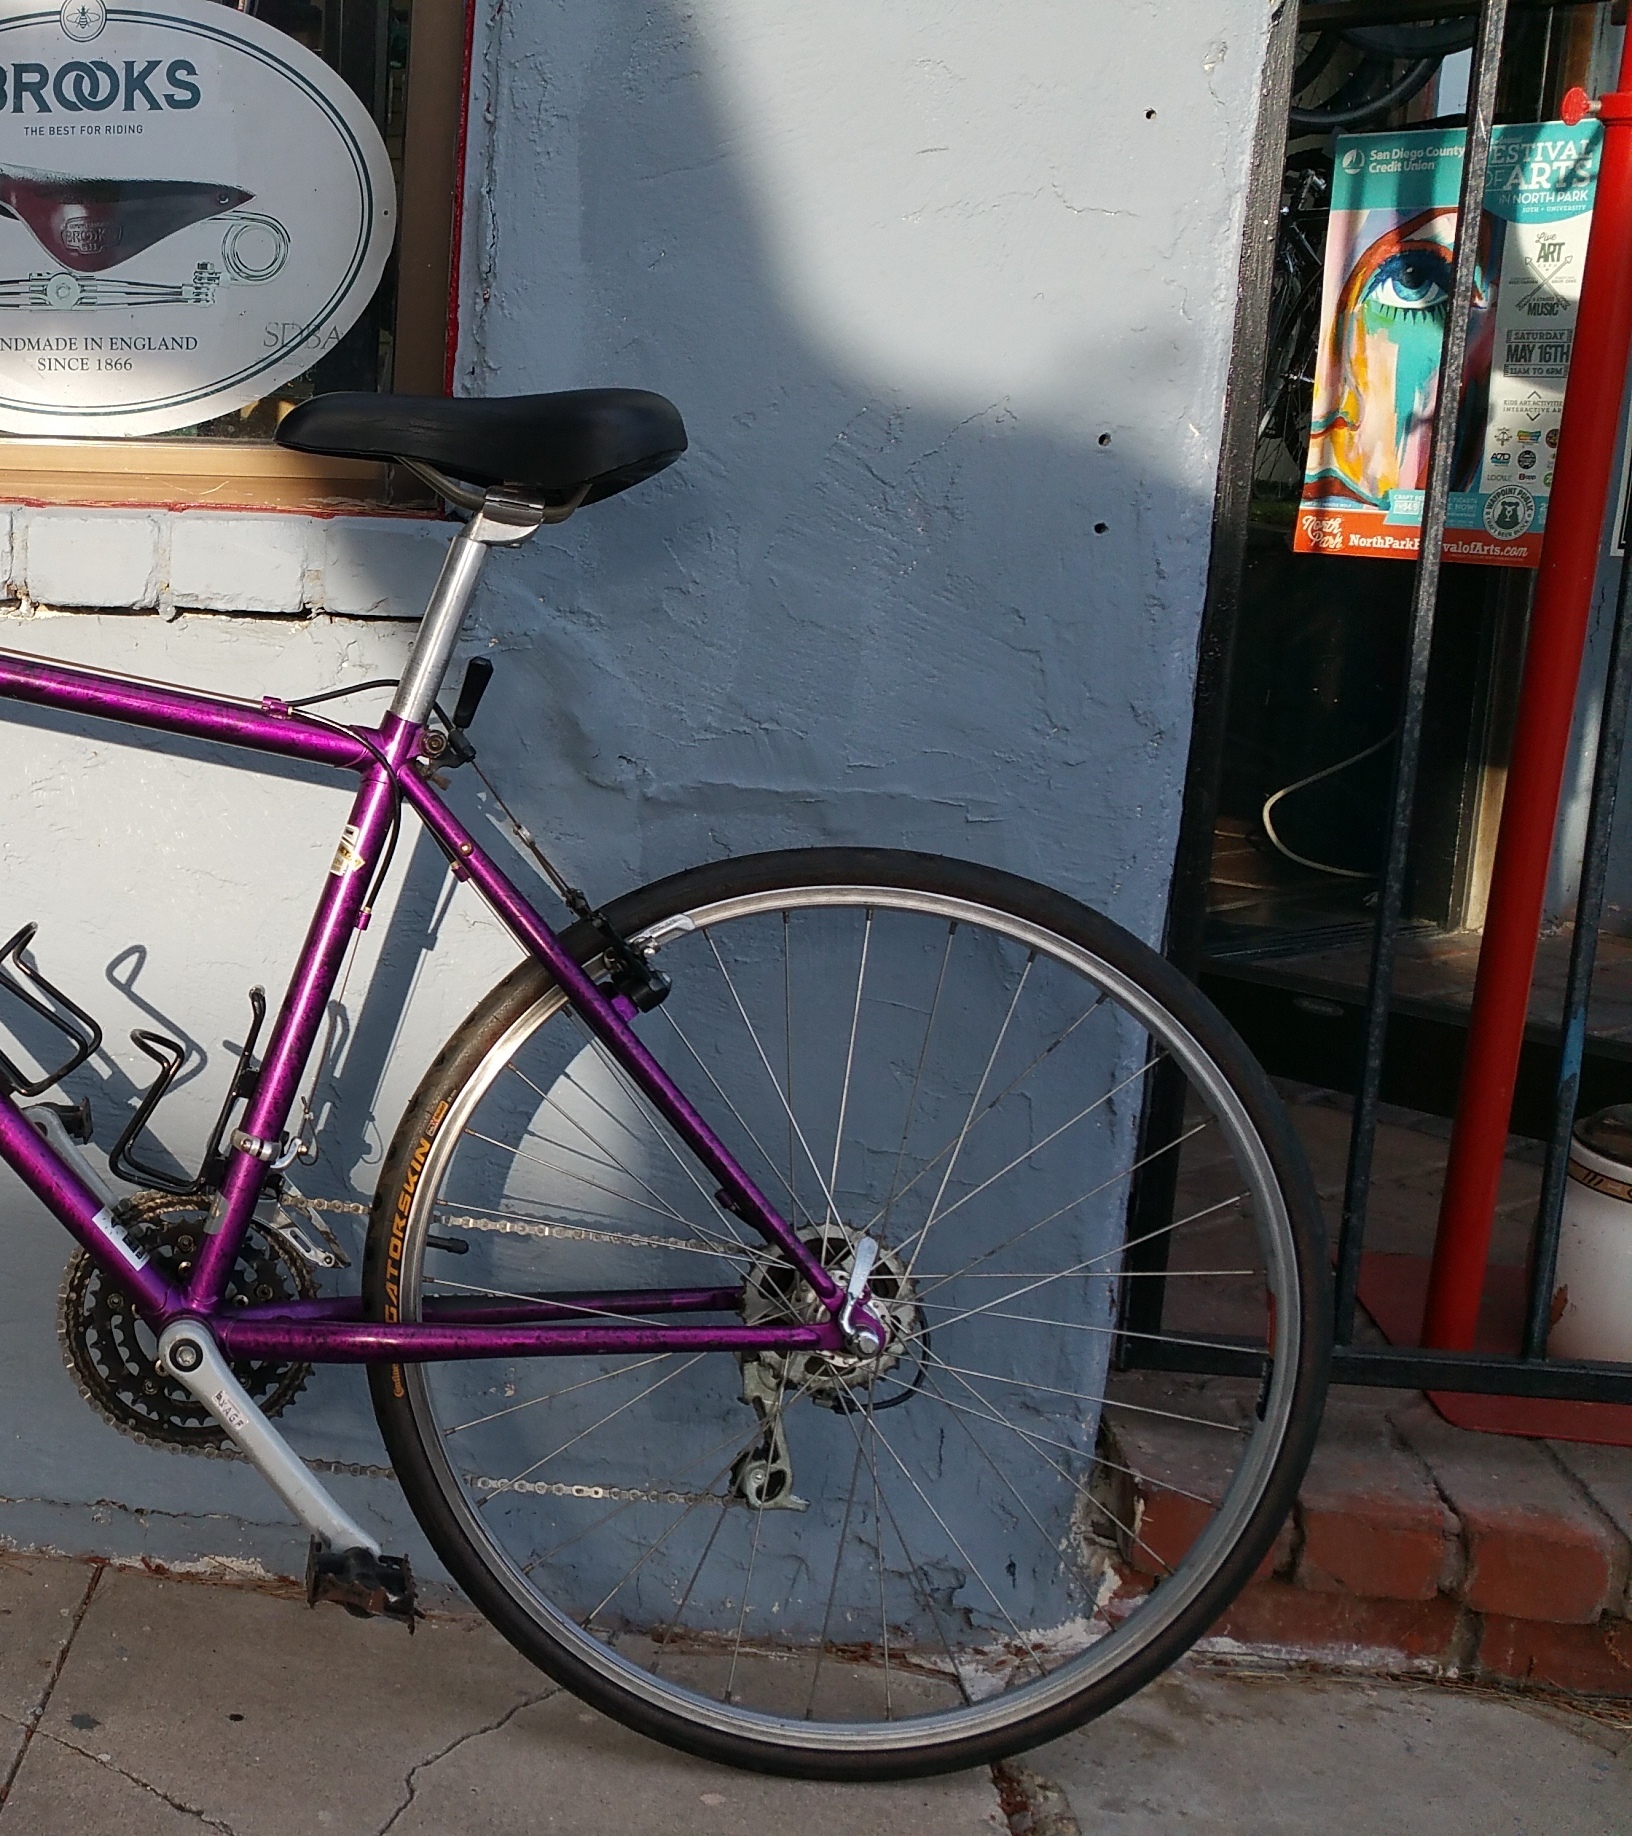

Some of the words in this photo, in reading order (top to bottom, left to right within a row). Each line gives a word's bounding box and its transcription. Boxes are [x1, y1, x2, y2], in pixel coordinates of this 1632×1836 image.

[24, 126, 45, 136] THE
[49, 126, 77, 136] BEST
[80, 125, 102, 135] FOR
[105, 124, 143, 135] RIDING
[1369, 148, 1390, 160] San
[1392, 147, 1424, 162] Diego
[1426, 144, 1466, 159] County
[1488, 139, 1593, 163] ESTIVAL
[1369, 161, 1402, 173] Credit
[1403, 160, 1435, 172] Union
[1503, 160, 1592, 190] ARTS
[1513, 190, 1554, 204] NORTH
[1556, 189, 1589, 203] PARK
[1537, 232, 1557, 241] Live
[1536, 241, 1566, 263] ART
[1527, 302, 1559, 316] MUSIC
[84, 337, 105, 352] IN
[109, 336, 199, 352] ENGLAND
[1513, 331, 1565, 341] SATURDAY
[1506, 344, 1536, 363] MAY
[1538, 343, 1571, 363] 16TH
[37, 357, 90, 373] SINCE
[95, 357, 133, 372] 1866
[1509, 367, 1530, 375] 11AM
[1532, 367, 1544, 375] TO
[1545, 367, 1563, 375] 6PM
[1485, 487, 1517, 510] WAYPOINT
[1517, 488, 1534, 512] PUBLIC
[1301, 515, 1343, 534] North
[1310, 531, 1344, 549] Park
[383, 1137, 432, 1324] GATORSKIN
